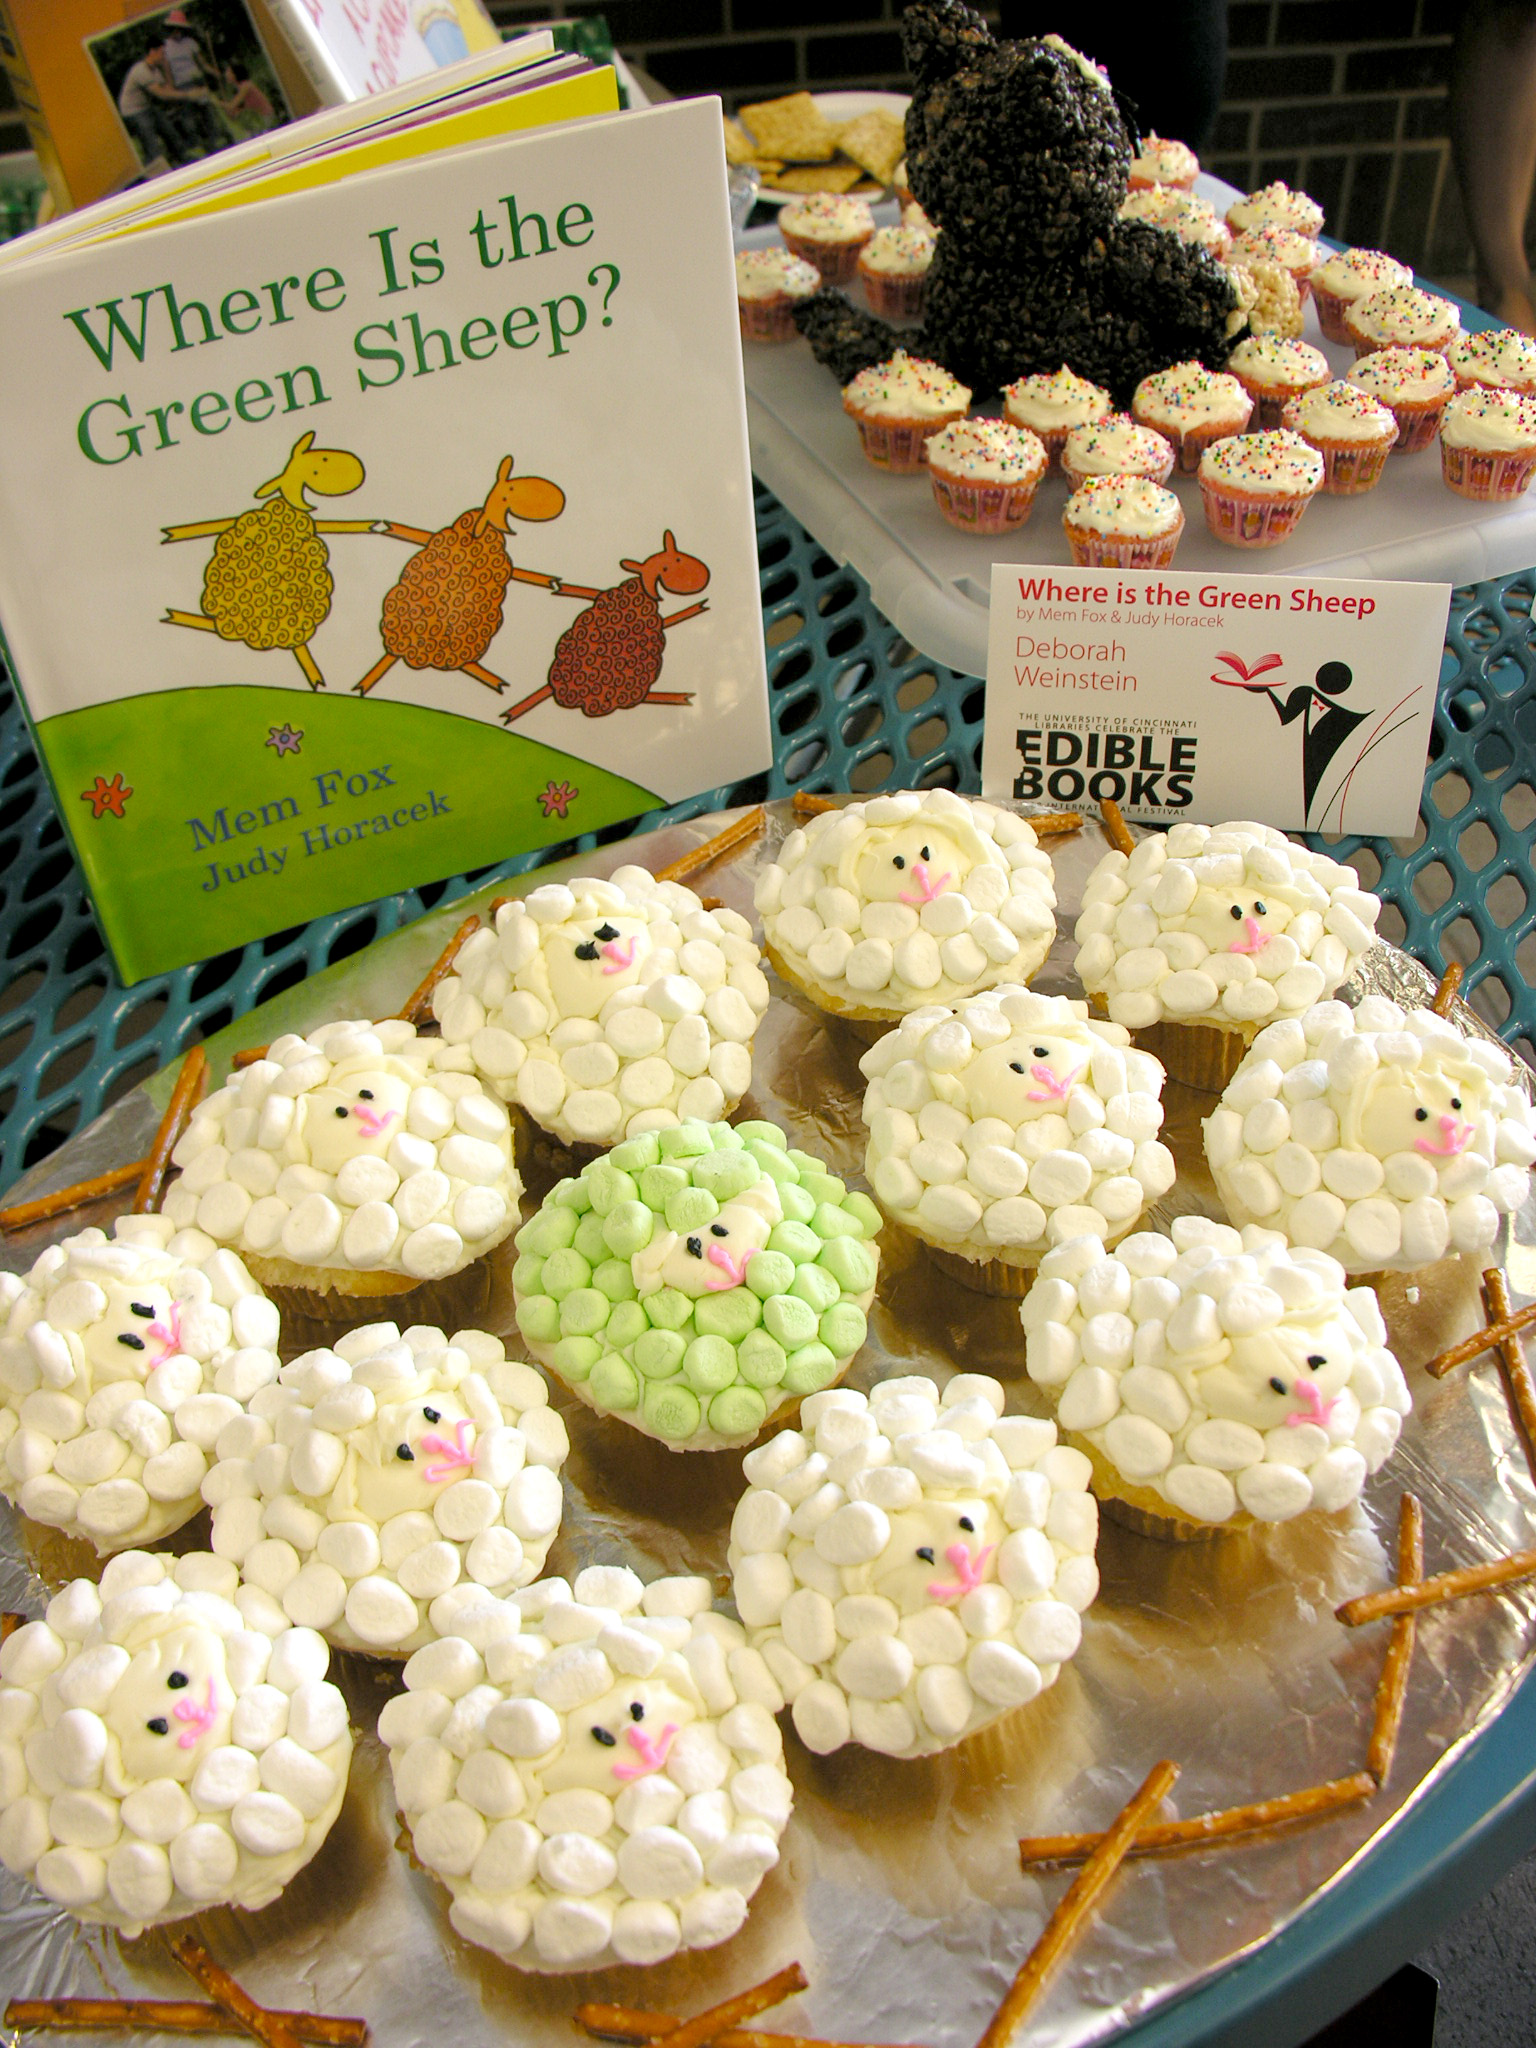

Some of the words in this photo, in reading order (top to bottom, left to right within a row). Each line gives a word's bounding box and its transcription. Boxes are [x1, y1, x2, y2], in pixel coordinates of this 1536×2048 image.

[64, 265, 346, 373] Where
[369, 227, 445, 297] Is
[469, 195, 595, 269] the
[78, 359, 331, 465] Green
[353, 264, 622, 392] Sheep?
[1017, 606, 1034, 622] by
[1038, 608, 1077, 622] Mem
[1082, 609, 1108, 623] Fox
[1111, 611, 1123, 624] &
[1125, 611, 1160, 628] Judy
[1164, 613, 1225, 628] Horacek
[1018, 578, 1109, 604] Where
[1117, 582, 1138, 605] is
[1145, 583, 1190, 607] the
[1198, 585, 1281, 611] Green
[1290, 589, 1376, 620] Sheep
[1016, 636, 1126, 662] Deborah
[1014, 665, 1138, 692] Weinstein
[1019, 713, 1039, 721] THE
[1045, 714, 1109, 725] UNIVERSITY
[1114, 717, 1128, 725] OF
[1133, 718, 1198, 729] CINCINNATI
[1035, 722, 1090, 731] LIBRARIES
[1096, 725, 1155, 735] CELEBRATE
[1160, 727, 1180, 736] THE
[1016, 729, 1198, 773] EDIBLE
[186, 797, 302, 852] Mem
[313, 764, 397, 808] Fox
[1013, 766, 1194, 808] BOOKS
[1137, 806, 1187, 816] FESTIVAL
[202, 845, 290, 893] Judy
[301, 790, 453, 857] Horacek
